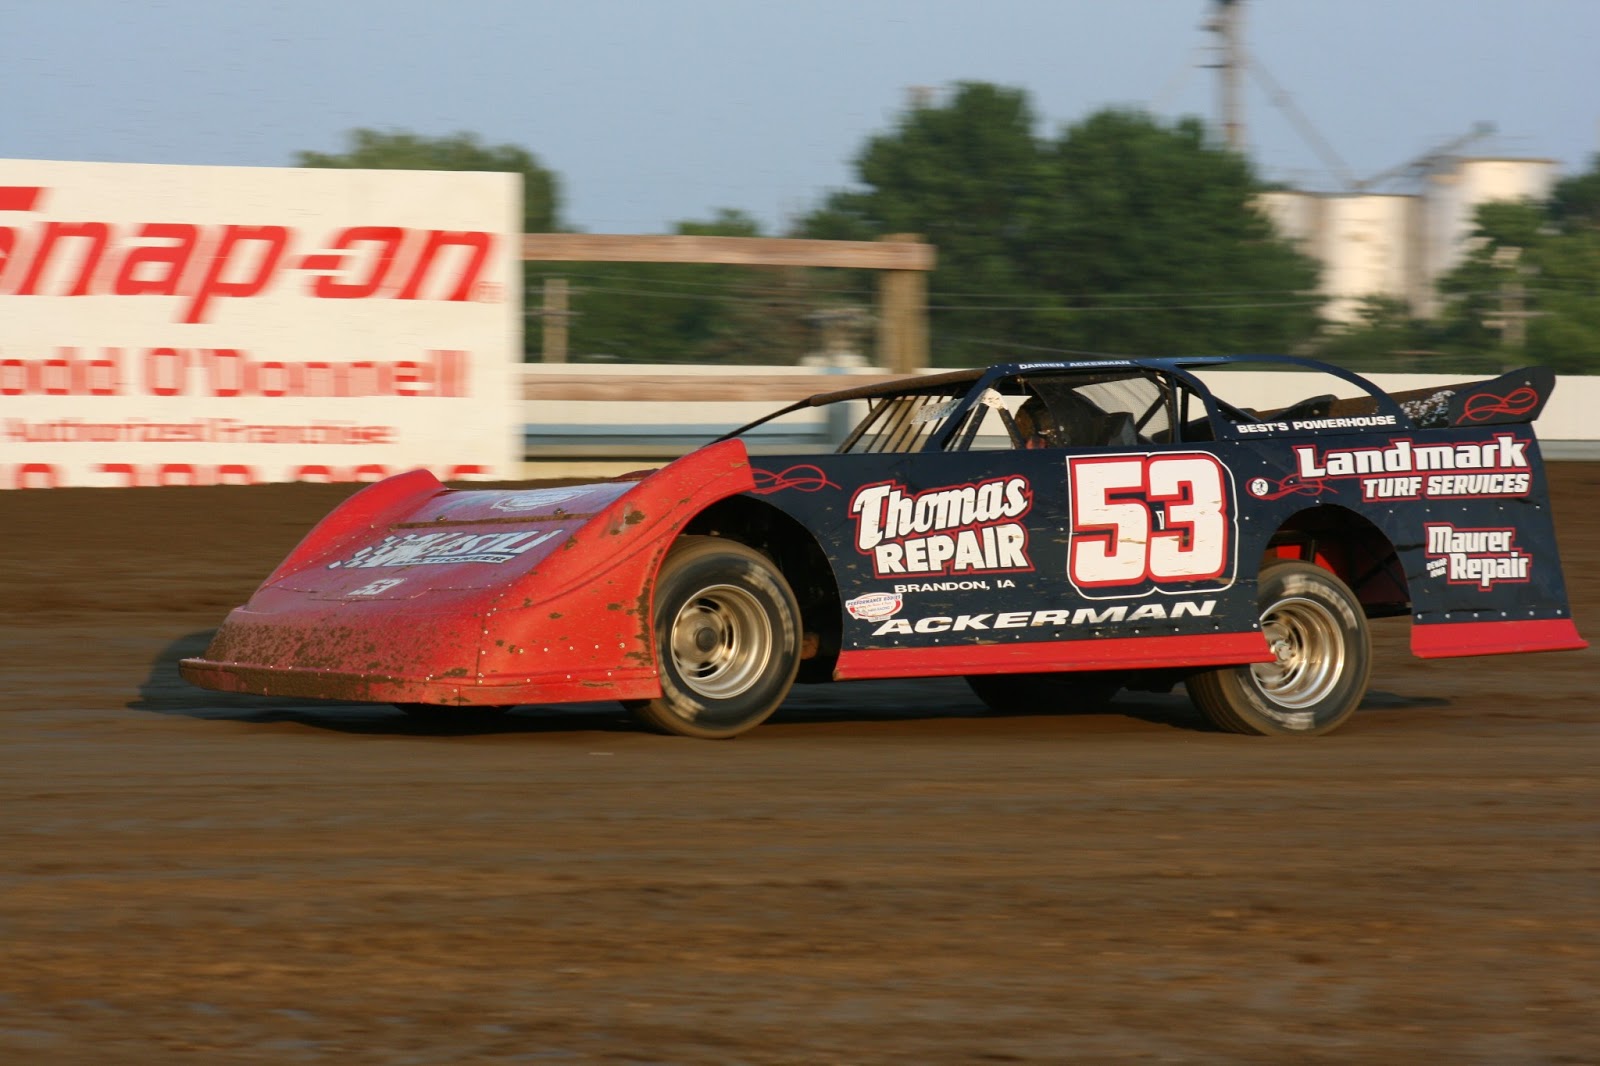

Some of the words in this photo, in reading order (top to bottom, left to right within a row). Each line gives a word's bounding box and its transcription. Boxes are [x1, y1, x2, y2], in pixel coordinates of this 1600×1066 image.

[0, 346, 126, 396] odd
[1018, 362, 1065, 370] DARREN
[1236, 421, 1290, 434] BEST'S
[1293, 415, 1397, 431] POWERHOUSE
[1296, 436, 1528, 478] Landmark
[1363, 475, 1423, 498] TURF
[1426, 472, 1531, 496] SERVICES
[852, 477, 1030, 551] Thomas
[1070, 454, 1229, 588] 53
[875, 523, 1029, 574] REPAIR
[1427, 526, 1513, 554] Maurer
[893, 580, 991, 594] BRANDON,
[997, 579, 1016, 589] IA
[1449, 551, 1529, 587] Repair
[871, 600, 1217, 637] ACKERMAN
